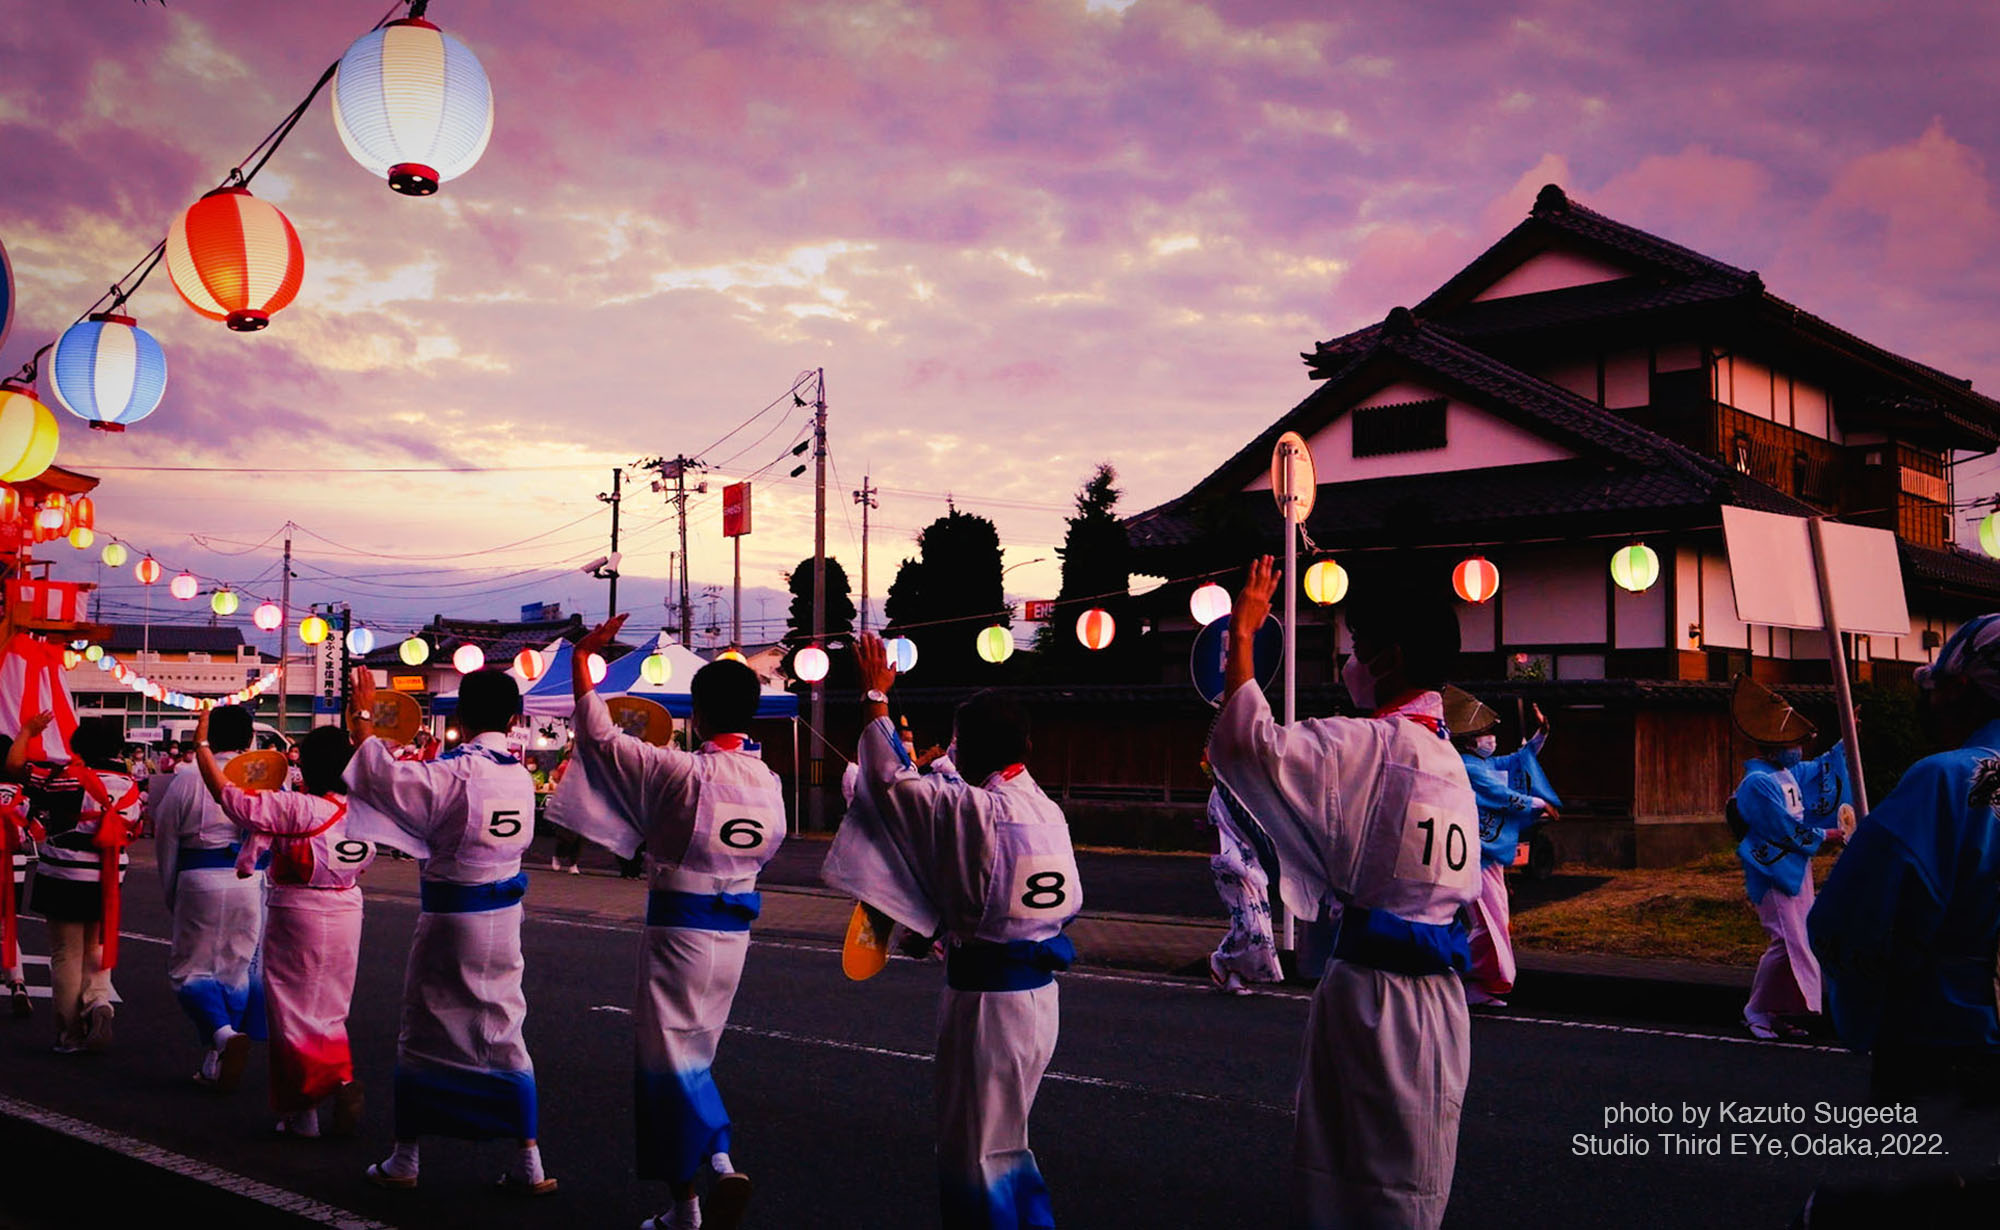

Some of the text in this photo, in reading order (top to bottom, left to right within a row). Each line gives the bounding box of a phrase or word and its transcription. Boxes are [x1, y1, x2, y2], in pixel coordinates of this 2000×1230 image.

[488, 810, 522, 838] 5
[719, 818, 764, 849] 6
[334, 839, 369, 863] 9
[1417, 817, 1467, 872] 10
[1021, 871, 1066, 910] 8
